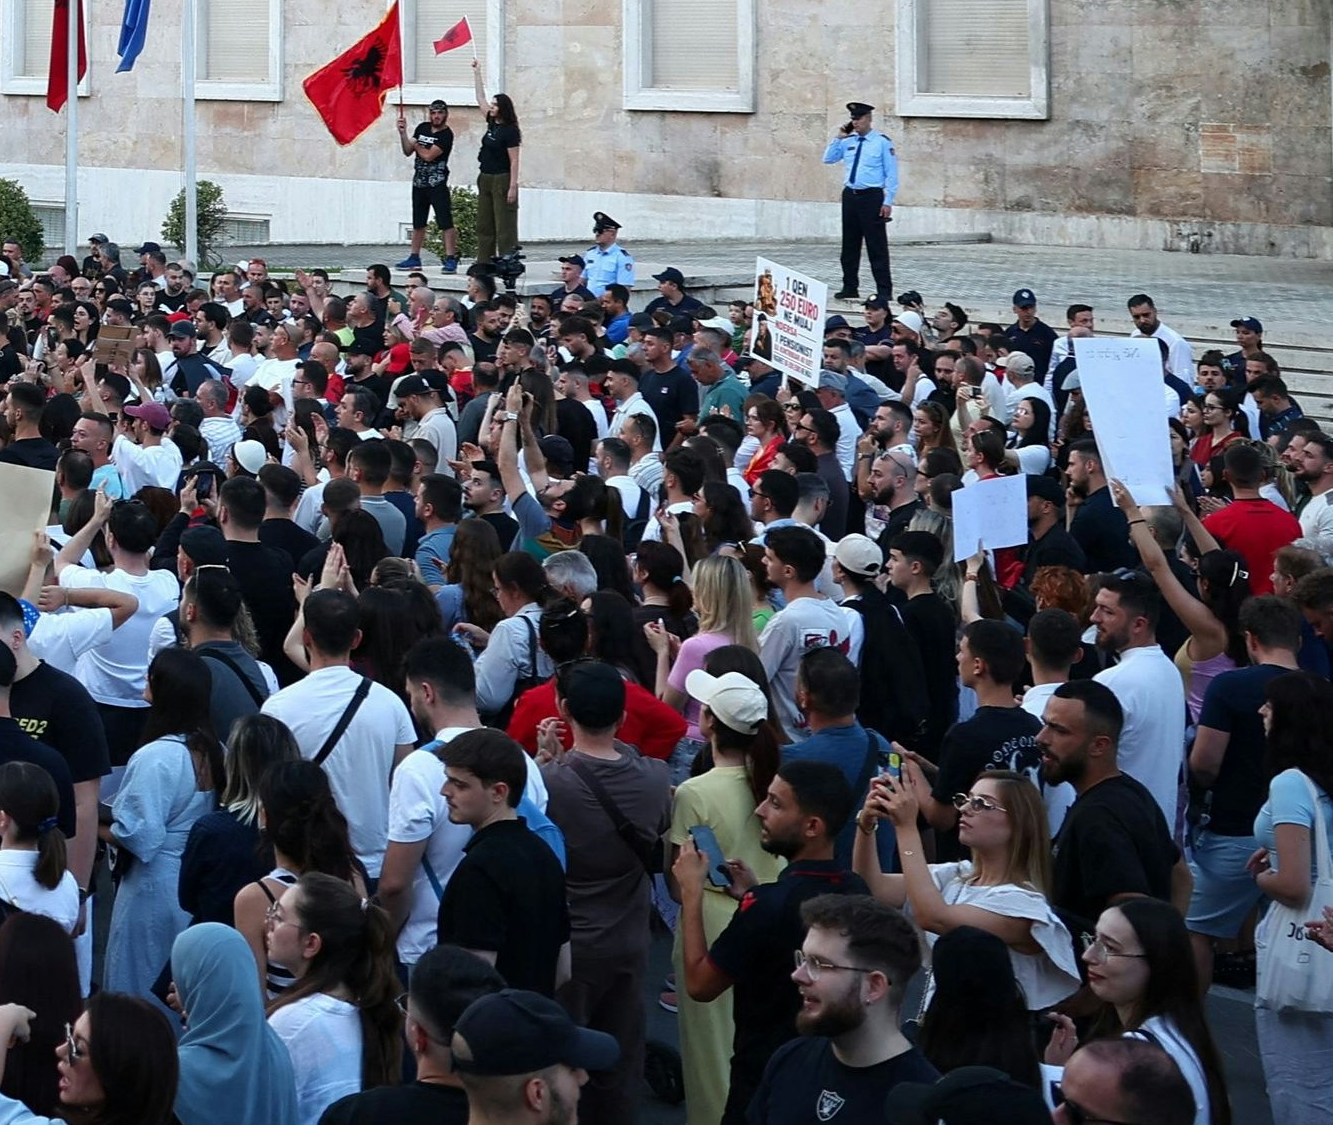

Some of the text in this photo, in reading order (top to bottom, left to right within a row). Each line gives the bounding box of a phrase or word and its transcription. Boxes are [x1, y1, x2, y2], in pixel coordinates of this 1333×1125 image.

[792, 279, 809, 297] QEN
[779, 290, 819, 321] 250 EURO
